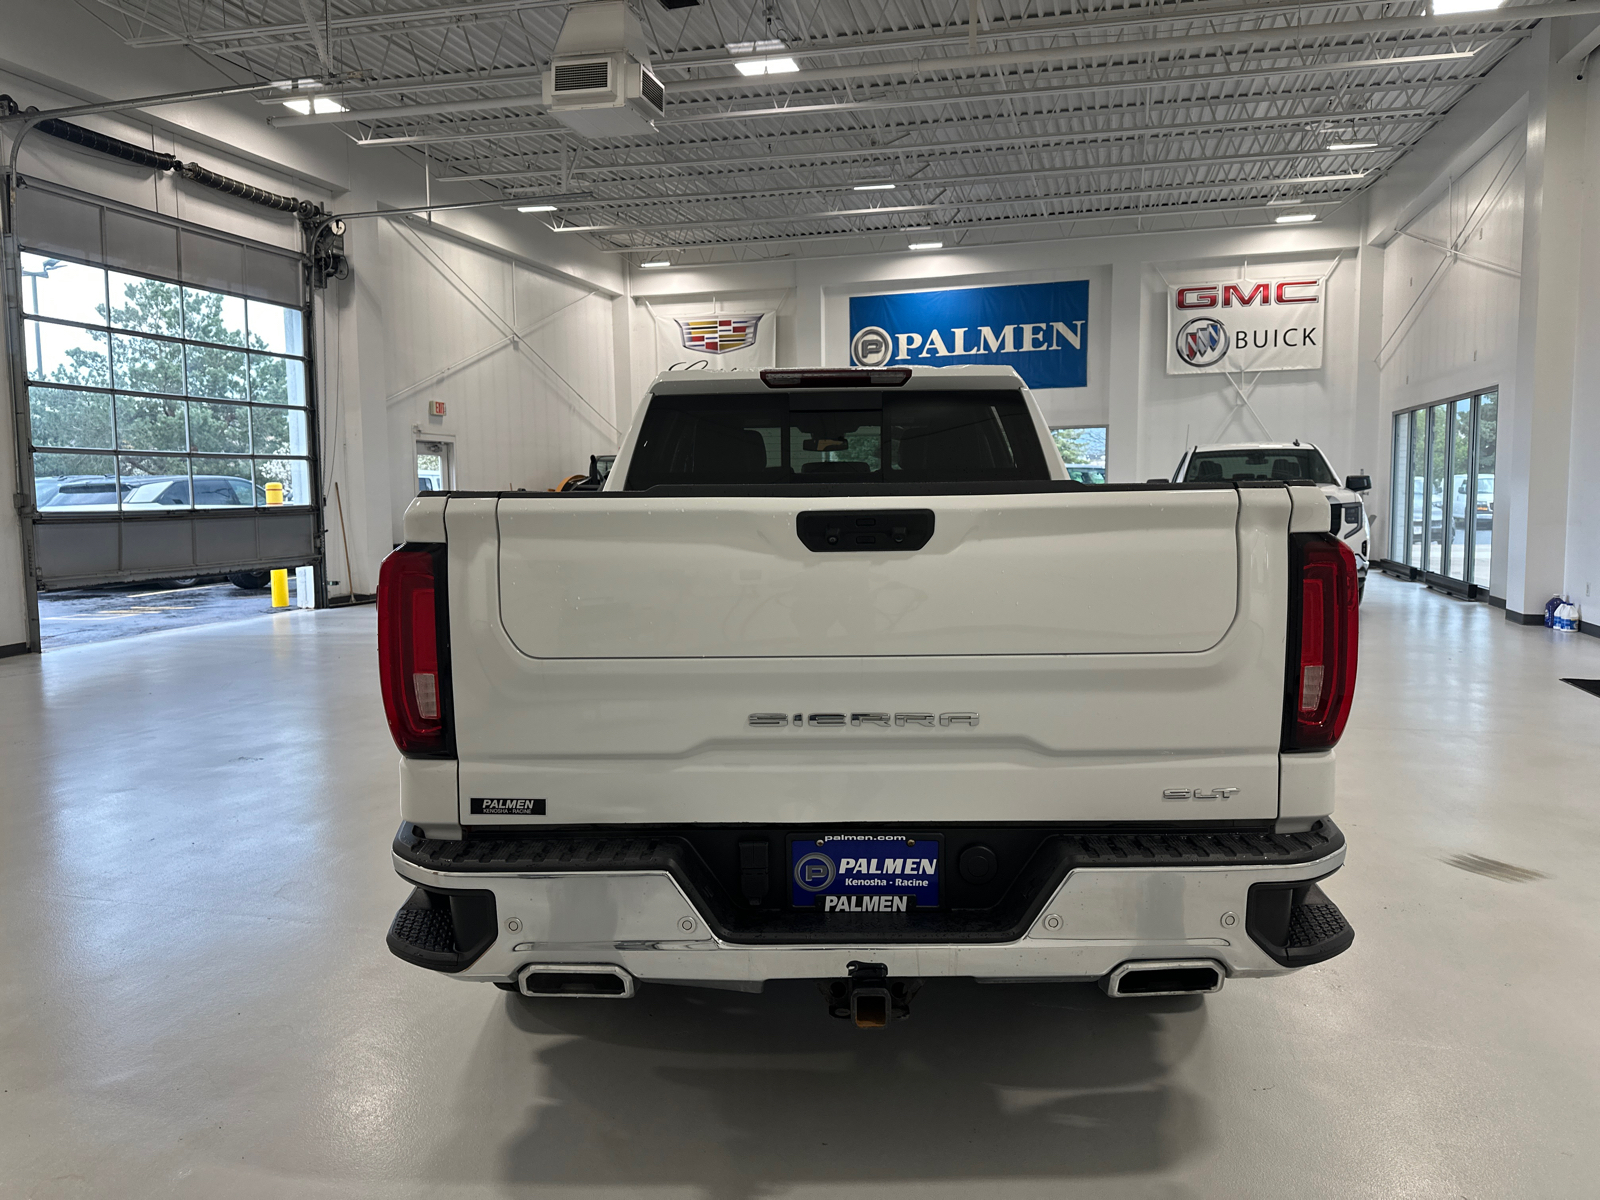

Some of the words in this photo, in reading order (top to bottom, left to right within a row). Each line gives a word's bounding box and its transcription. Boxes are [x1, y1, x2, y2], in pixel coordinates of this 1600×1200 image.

[1176, 279, 1320, 310] GMC
[895, 320, 1086, 360] PALMEN
[1235, 327, 1317, 350] BUICK
[748, 712, 980, 727] SIERRA
[1163, 787, 1241, 799] SLT
[482, 799, 534, 808] PALMEN
[824, 834, 906, 842] palmen.com
[838, 858, 937, 874] PALMEN
[845, 878, 887, 887] Kenosha
[895, 878, 929, 887] Racine
[824, 895, 908, 912] PALMEN
